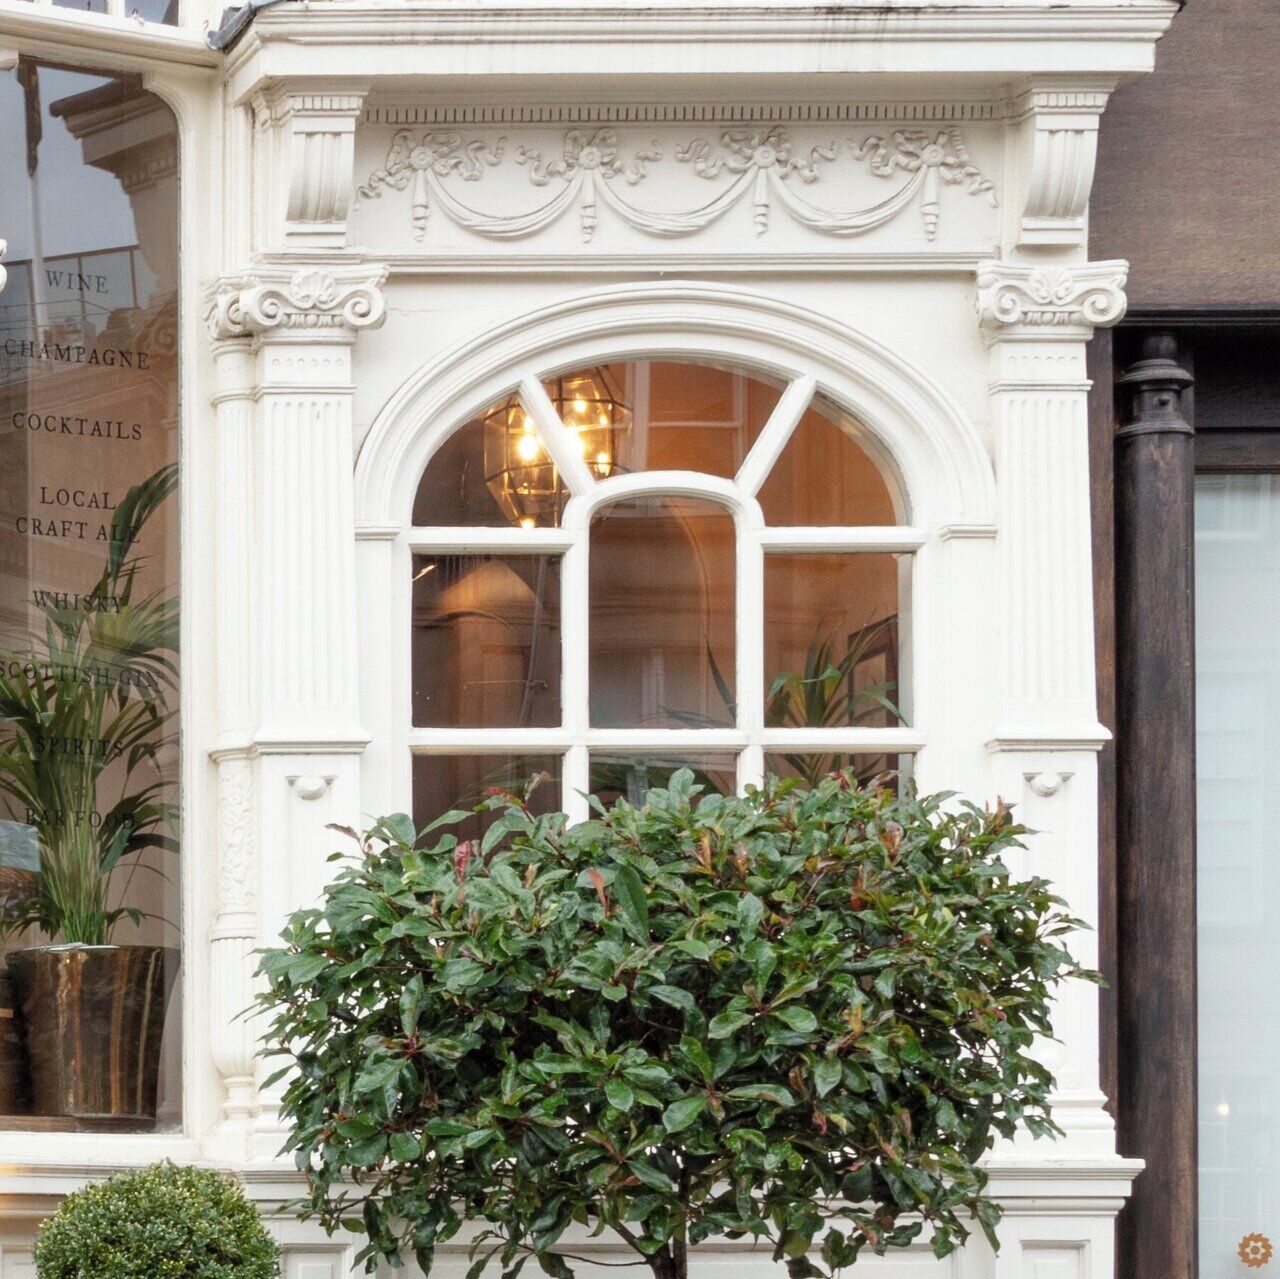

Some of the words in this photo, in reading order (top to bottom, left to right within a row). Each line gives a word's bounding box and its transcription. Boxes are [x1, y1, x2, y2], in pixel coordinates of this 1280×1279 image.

[46, 270, 109, 294] WINE
[4, 339, 151, 370] CHAMPAGNE
[12, 412, 143, 441] COCKTAILS
[40, 486, 116, 510] LOCAL
[16, 517, 88, 540] CRAFT
[96, 524, 141, 544] ALE
[32, 590, 127, 614] WHISKY
[118, 669, 161, 689] GIN
[35, 735, 124, 757] SPIRITS
[25, 807, 65, 827] BAR
[75, 809, 135, 829] FOOD
